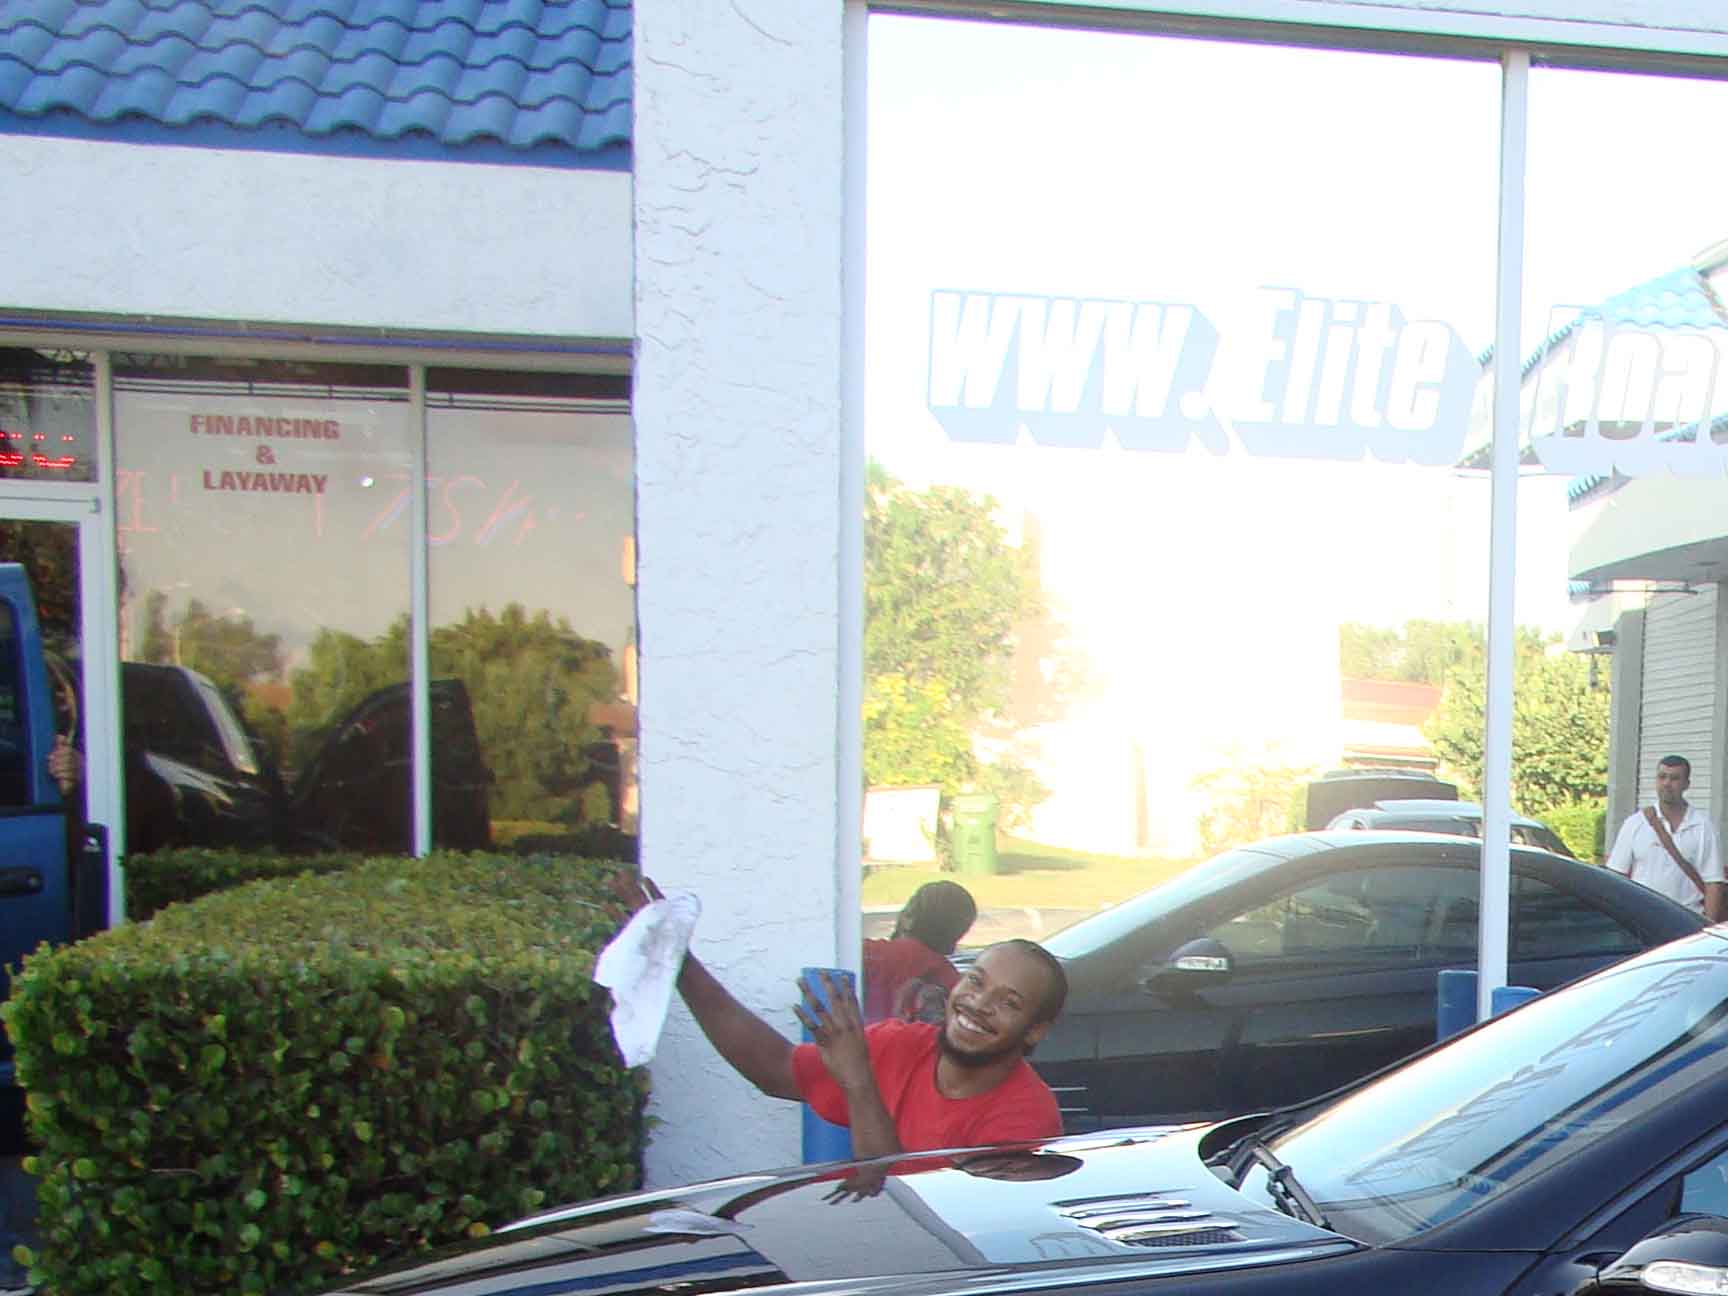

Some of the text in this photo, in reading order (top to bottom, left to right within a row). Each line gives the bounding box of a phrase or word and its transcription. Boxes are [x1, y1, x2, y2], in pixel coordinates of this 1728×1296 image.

[190, 414, 341, 440] FINANCING
[255, 444, 277, 465] &
[203, 469, 328, 494] LAYAWAY
